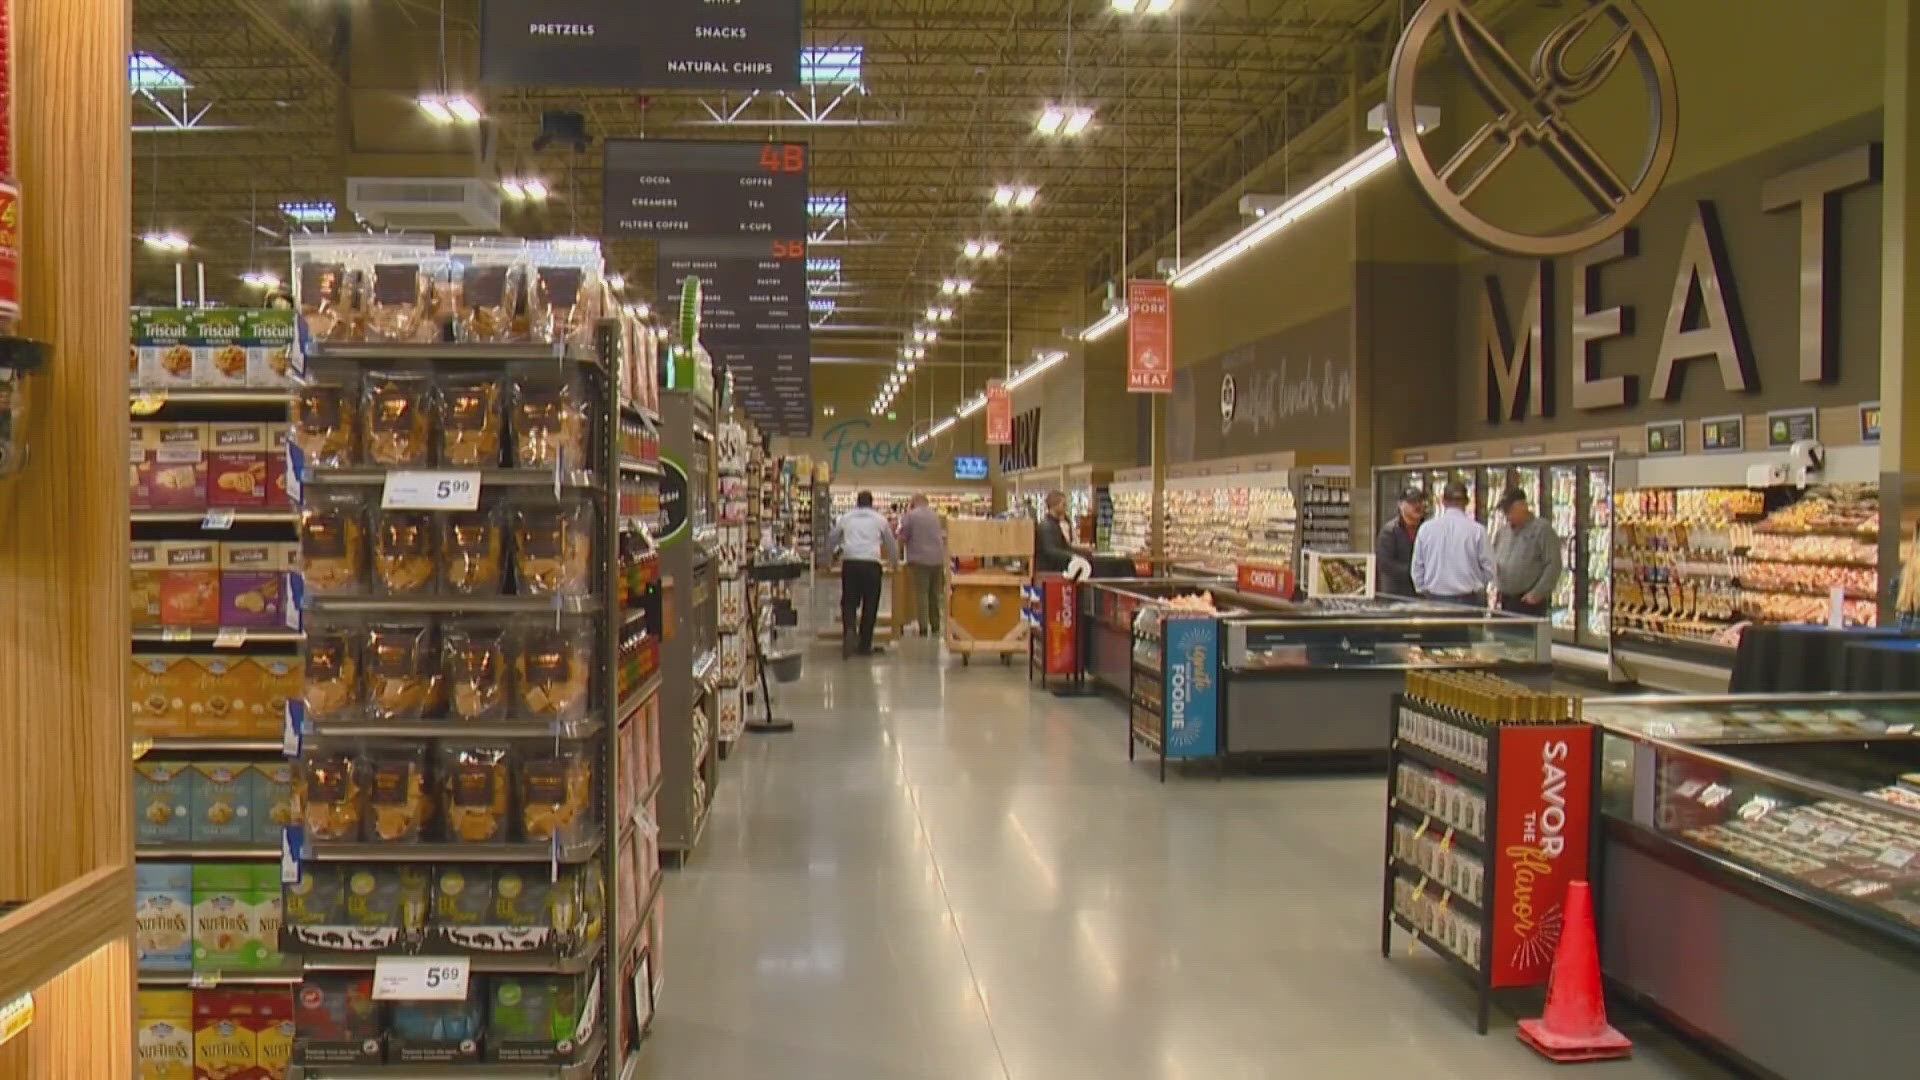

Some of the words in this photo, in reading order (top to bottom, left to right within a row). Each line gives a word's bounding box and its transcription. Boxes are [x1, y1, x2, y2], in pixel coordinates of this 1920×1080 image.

[529, 24, 595, 36] PRETZELS
[695, 26, 747, 39] SNACKS
[667, 60, 730, 74] NATURAL
[734, 62, 774, 75] CHIPS
[759, 143, 804, 173] 4B
[639, 175, 671, 185] COCOA
[739, 177, 774, 187] COFFEE
[631, 197, 678, 208] CREAMERS
[748, 199, 765, 209] TEA
[619, 219, 653, 230] FILTERS
[655, 220, 689, 231] COFFEE
[739, 222, 773, 232] K-CUPS
[772, 240, 805, 258] 5B
[1479, 142, 1882, 423] MEAT
[1133, 303, 1167, 314] PORK
[143, 323, 188, 338] Triscuit
[197, 323, 241, 338] Triscuit
[251, 323, 294, 338] Triscuit
[1131, 374, 1169, 386] MEAT
[1171, 663, 1185, 730] FOODIE
[1539, 740, 1569, 860] SAVOR
[1523, 810, 1537, 843] THE
[1506, 843, 1552, 938] flavor
